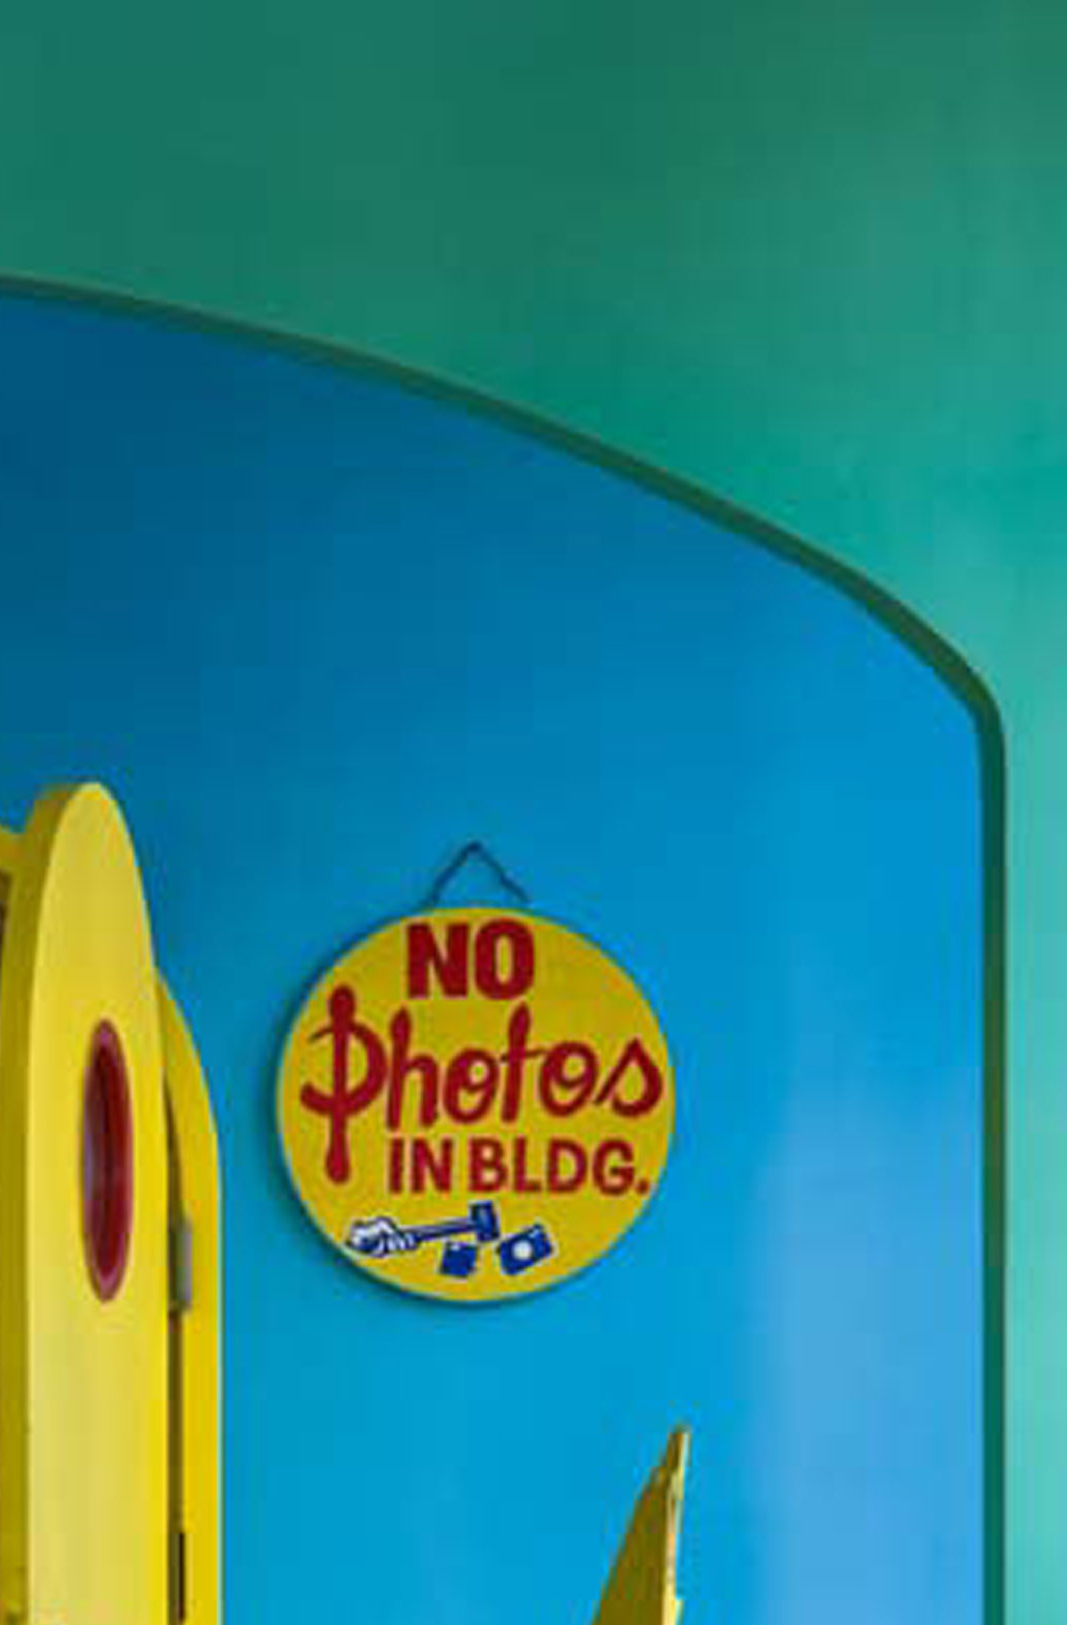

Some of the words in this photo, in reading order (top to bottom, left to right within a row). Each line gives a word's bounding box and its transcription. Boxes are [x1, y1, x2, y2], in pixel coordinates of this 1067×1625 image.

[407, 918, 535, 1000] NO
[300, 984, 664, 1185] Photos
[388, 1137, 453, 1194] IN
[467, 1137, 650, 1197] BLDG.
